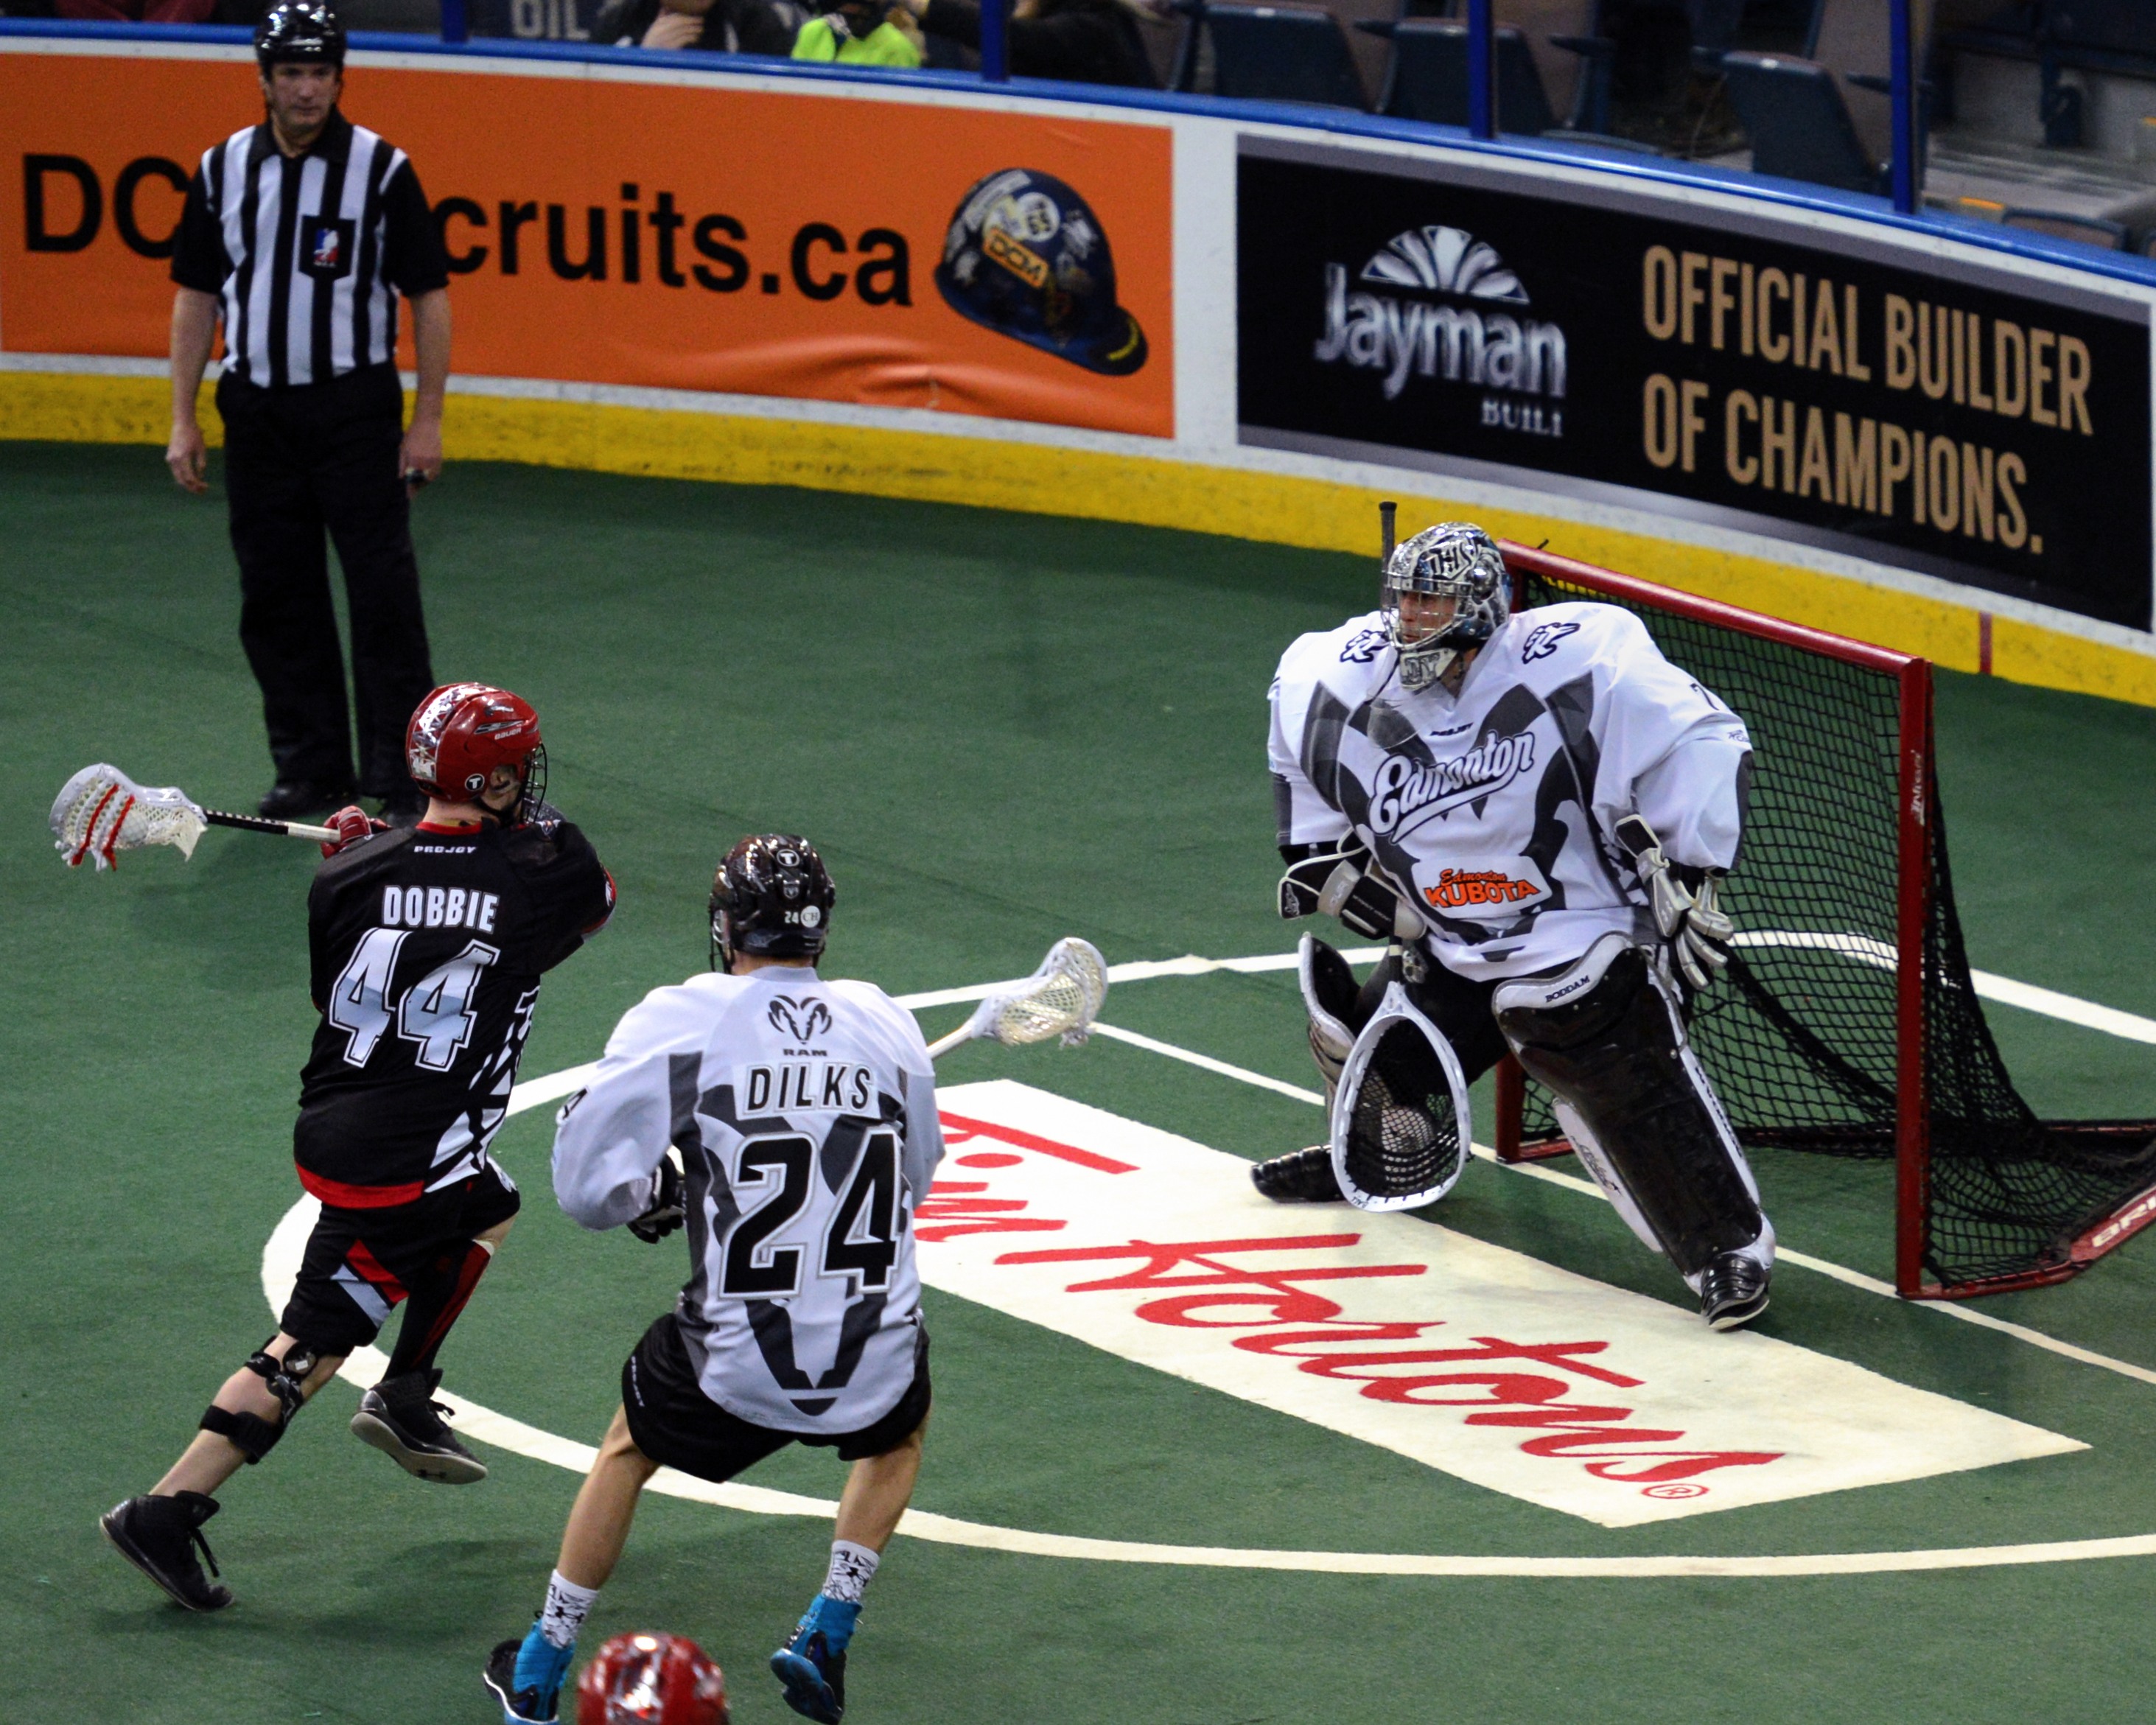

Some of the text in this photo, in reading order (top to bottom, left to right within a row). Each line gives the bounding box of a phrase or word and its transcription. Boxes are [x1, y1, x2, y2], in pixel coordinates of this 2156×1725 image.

[1314, 262, 1567, 400] Jayman
[1643, 245, 2093, 435] OFFICIAL BUILDER
[1643, 373, 2043, 554] OF CHAMPIONS.
[1369, 729, 1535, 841] Edmonton
[413, 845, 476, 853] PROJOY
[1440, 868, 1508, 886] Edmonton
[382, 885, 500, 934] DOBBIE
[784, 911, 799, 924] 24
[1424, 879, 1541, 908] KUBOTA
[329, 927, 501, 1071] 44
[745, 1064, 872, 1113] DILKS
[783, 1048, 827, 1057] RAM
[719, 1127, 901, 1298] 24
[993, 1233, 1785, 1483] Hortons
